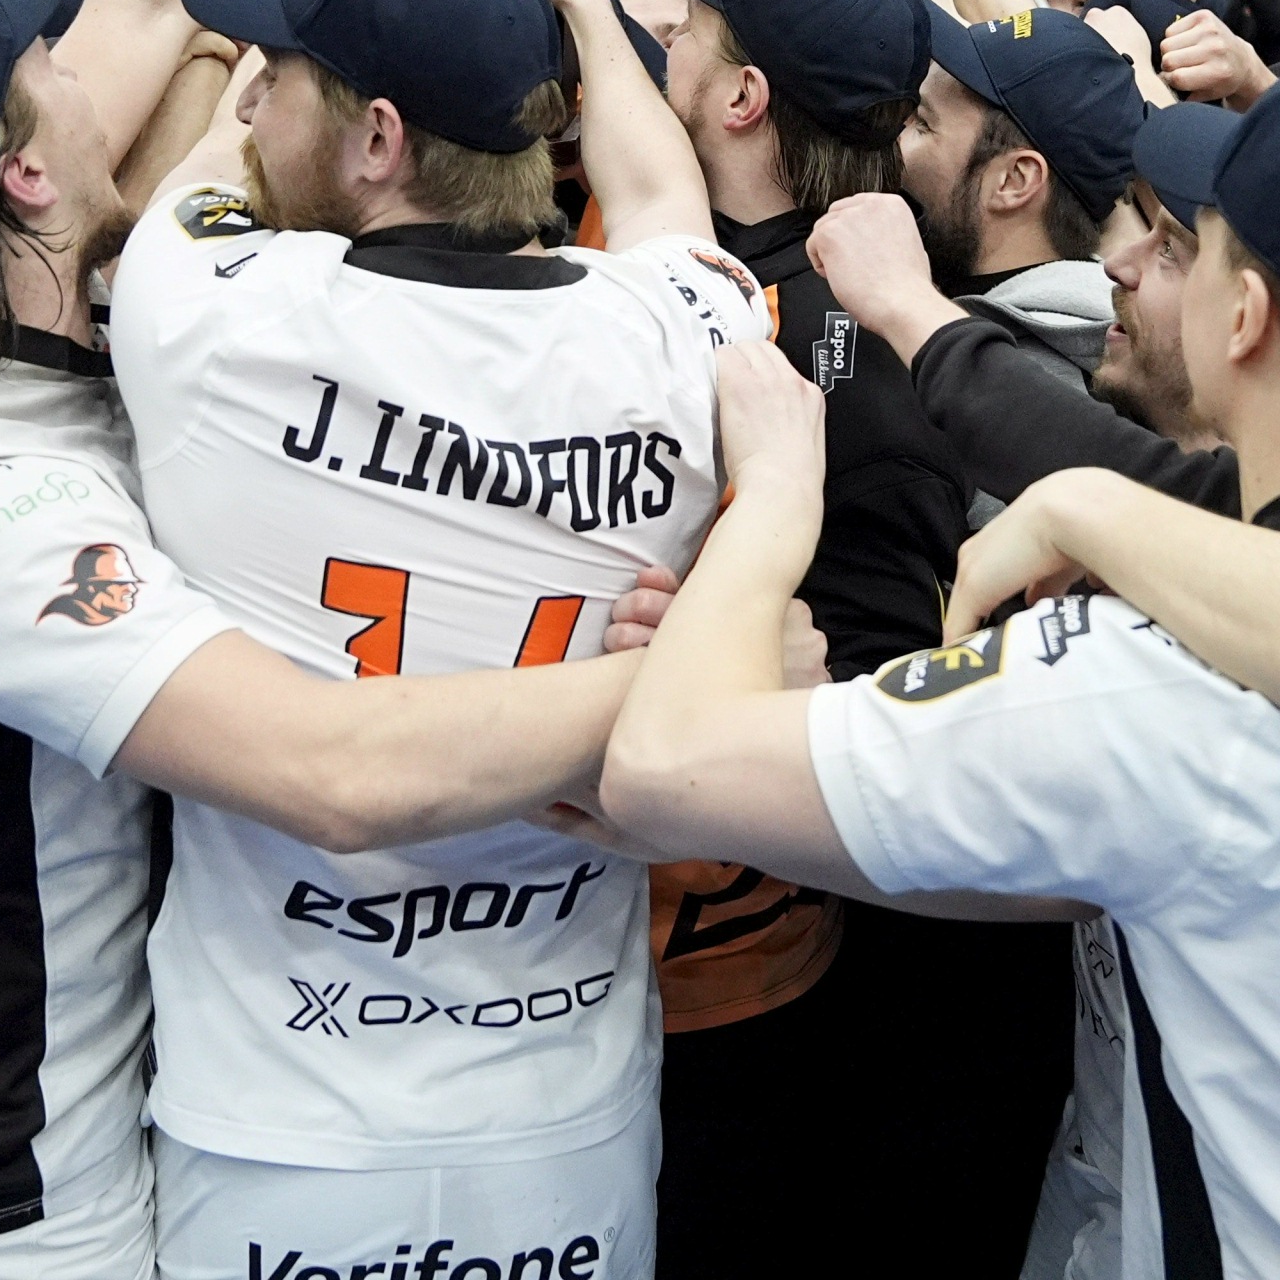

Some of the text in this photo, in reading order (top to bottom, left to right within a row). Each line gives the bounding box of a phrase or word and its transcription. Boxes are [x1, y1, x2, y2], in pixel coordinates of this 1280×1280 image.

[817, 348, 830, 387] liikkuu
[830, 319, 850, 370] Espoo
[280, 373, 683, 533] J. LINDFORS
[282, 860, 607, 959] esport
[357, 970, 616, 1029] OXDOG
